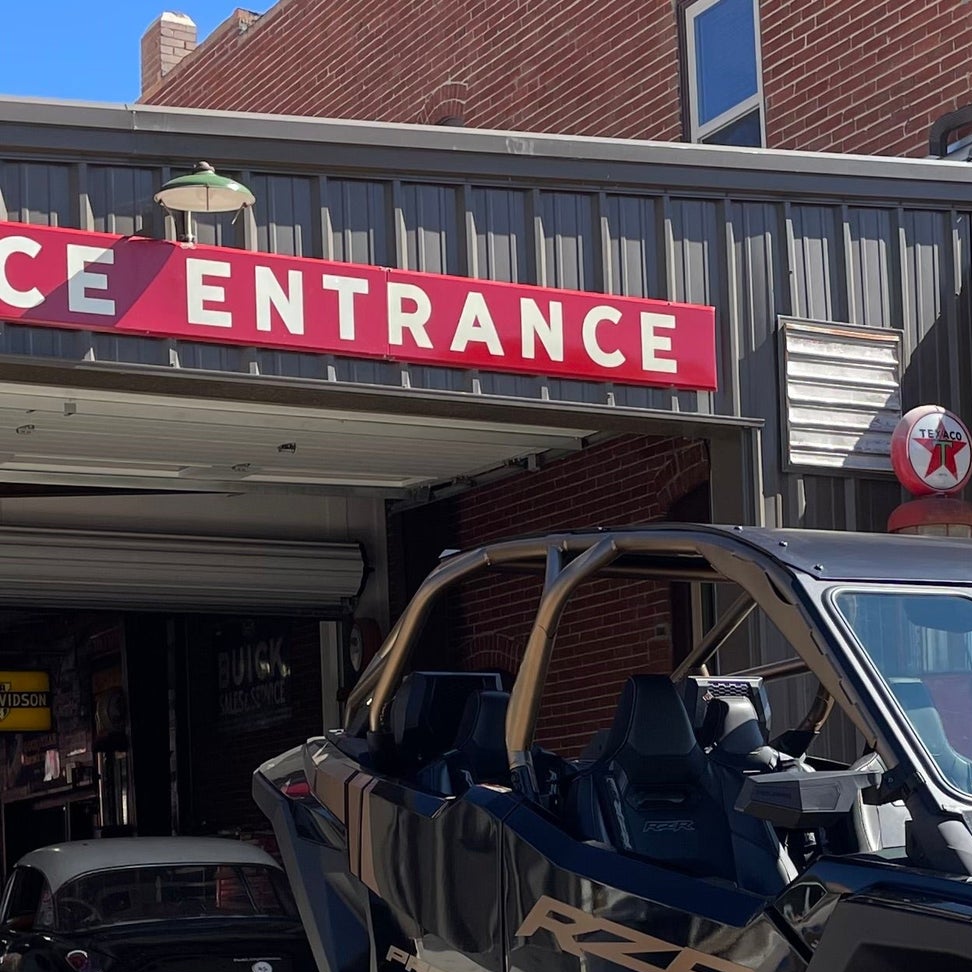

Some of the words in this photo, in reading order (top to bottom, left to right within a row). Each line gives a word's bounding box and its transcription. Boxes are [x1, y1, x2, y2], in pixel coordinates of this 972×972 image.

[185, 256, 678, 374] ENTRANCE
[919, 428, 962, 441] TEXACO
[218, 637, 286, 689] BUICK
